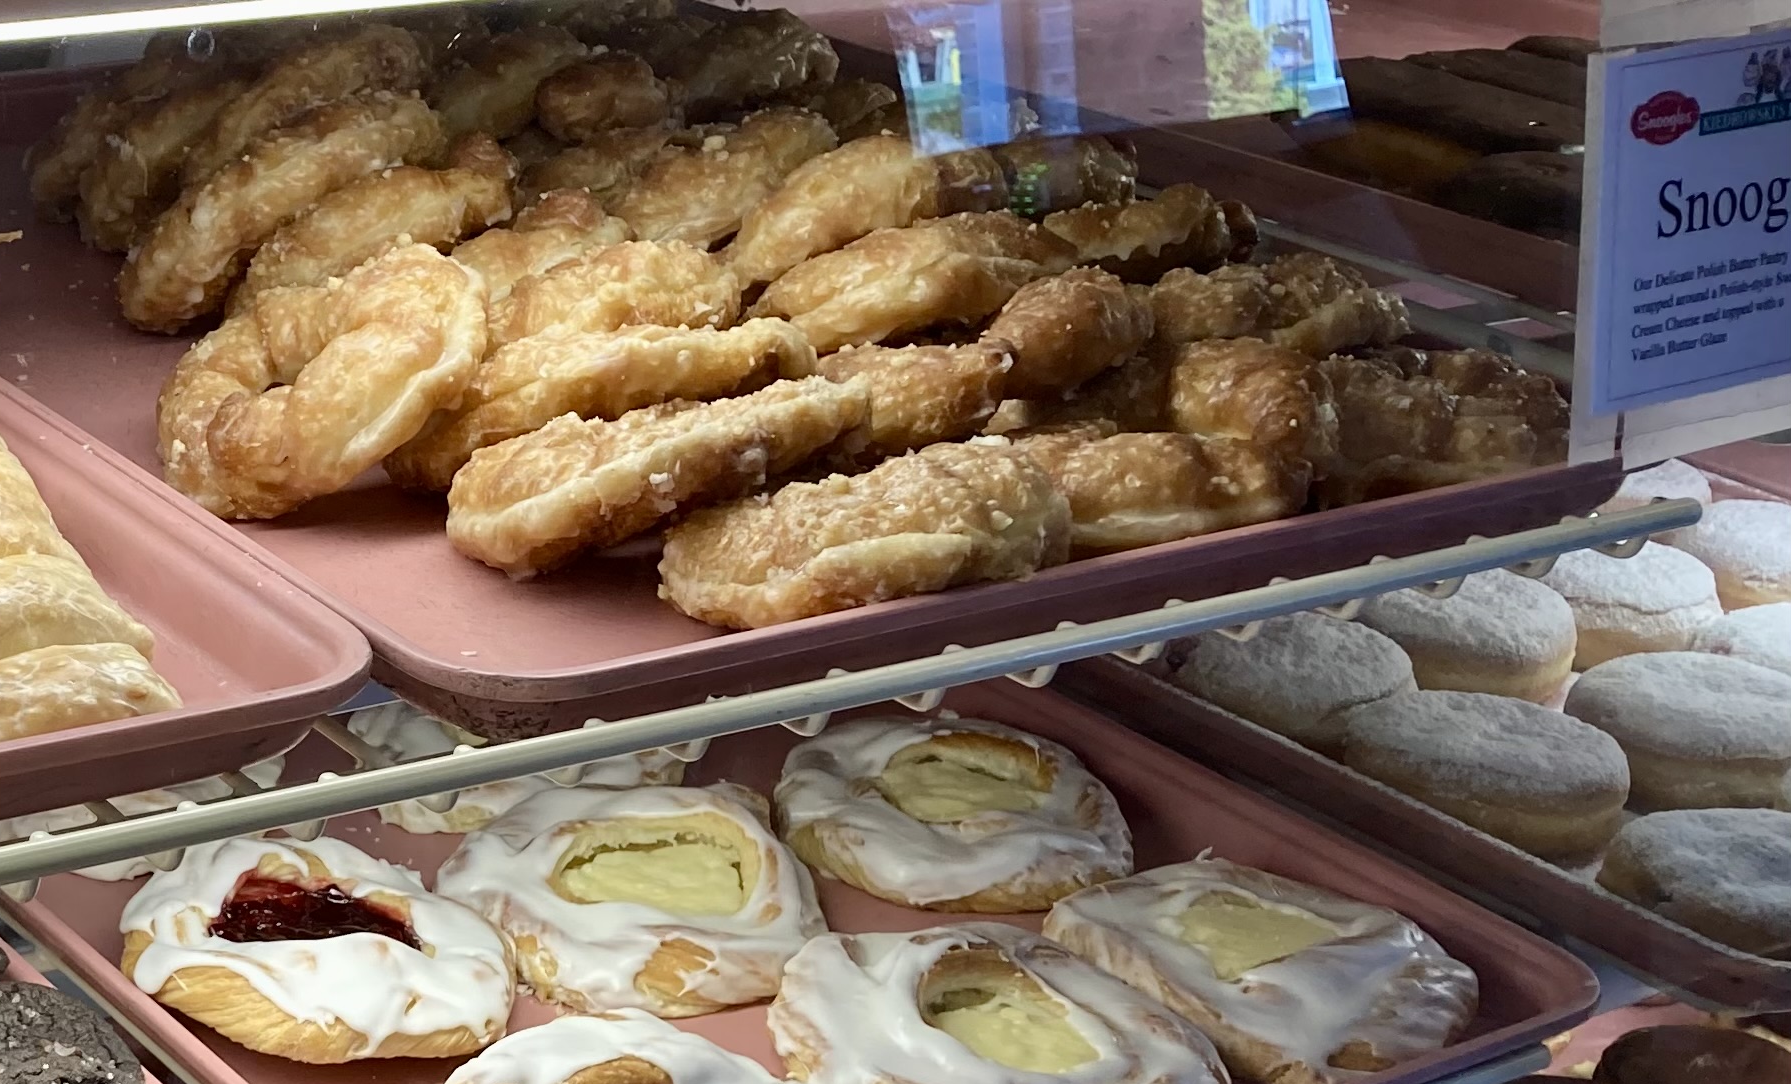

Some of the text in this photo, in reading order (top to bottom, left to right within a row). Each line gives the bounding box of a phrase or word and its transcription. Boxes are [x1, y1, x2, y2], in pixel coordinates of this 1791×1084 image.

[1633, 278, 1653, 292] Our
[1655, 270, 1695, 288] Delicate
[1697, 261, 1727, 279] Polish
[1729, 257, 1758, 273] Butter
[1631, 324, 1663, 339] Cream
[1665, 316, 1701, 331] Cheese
[1703, 307, 1721, 323] and
[1722, 301, 1754, 321] topped
[1756, 296, 1777, 311] with
[1633, 293, 1674, 315] wrapped
[1675, 288, 1709, 306] around
[1631, 332, 1728, 362] Vanilla Butter Glaze
